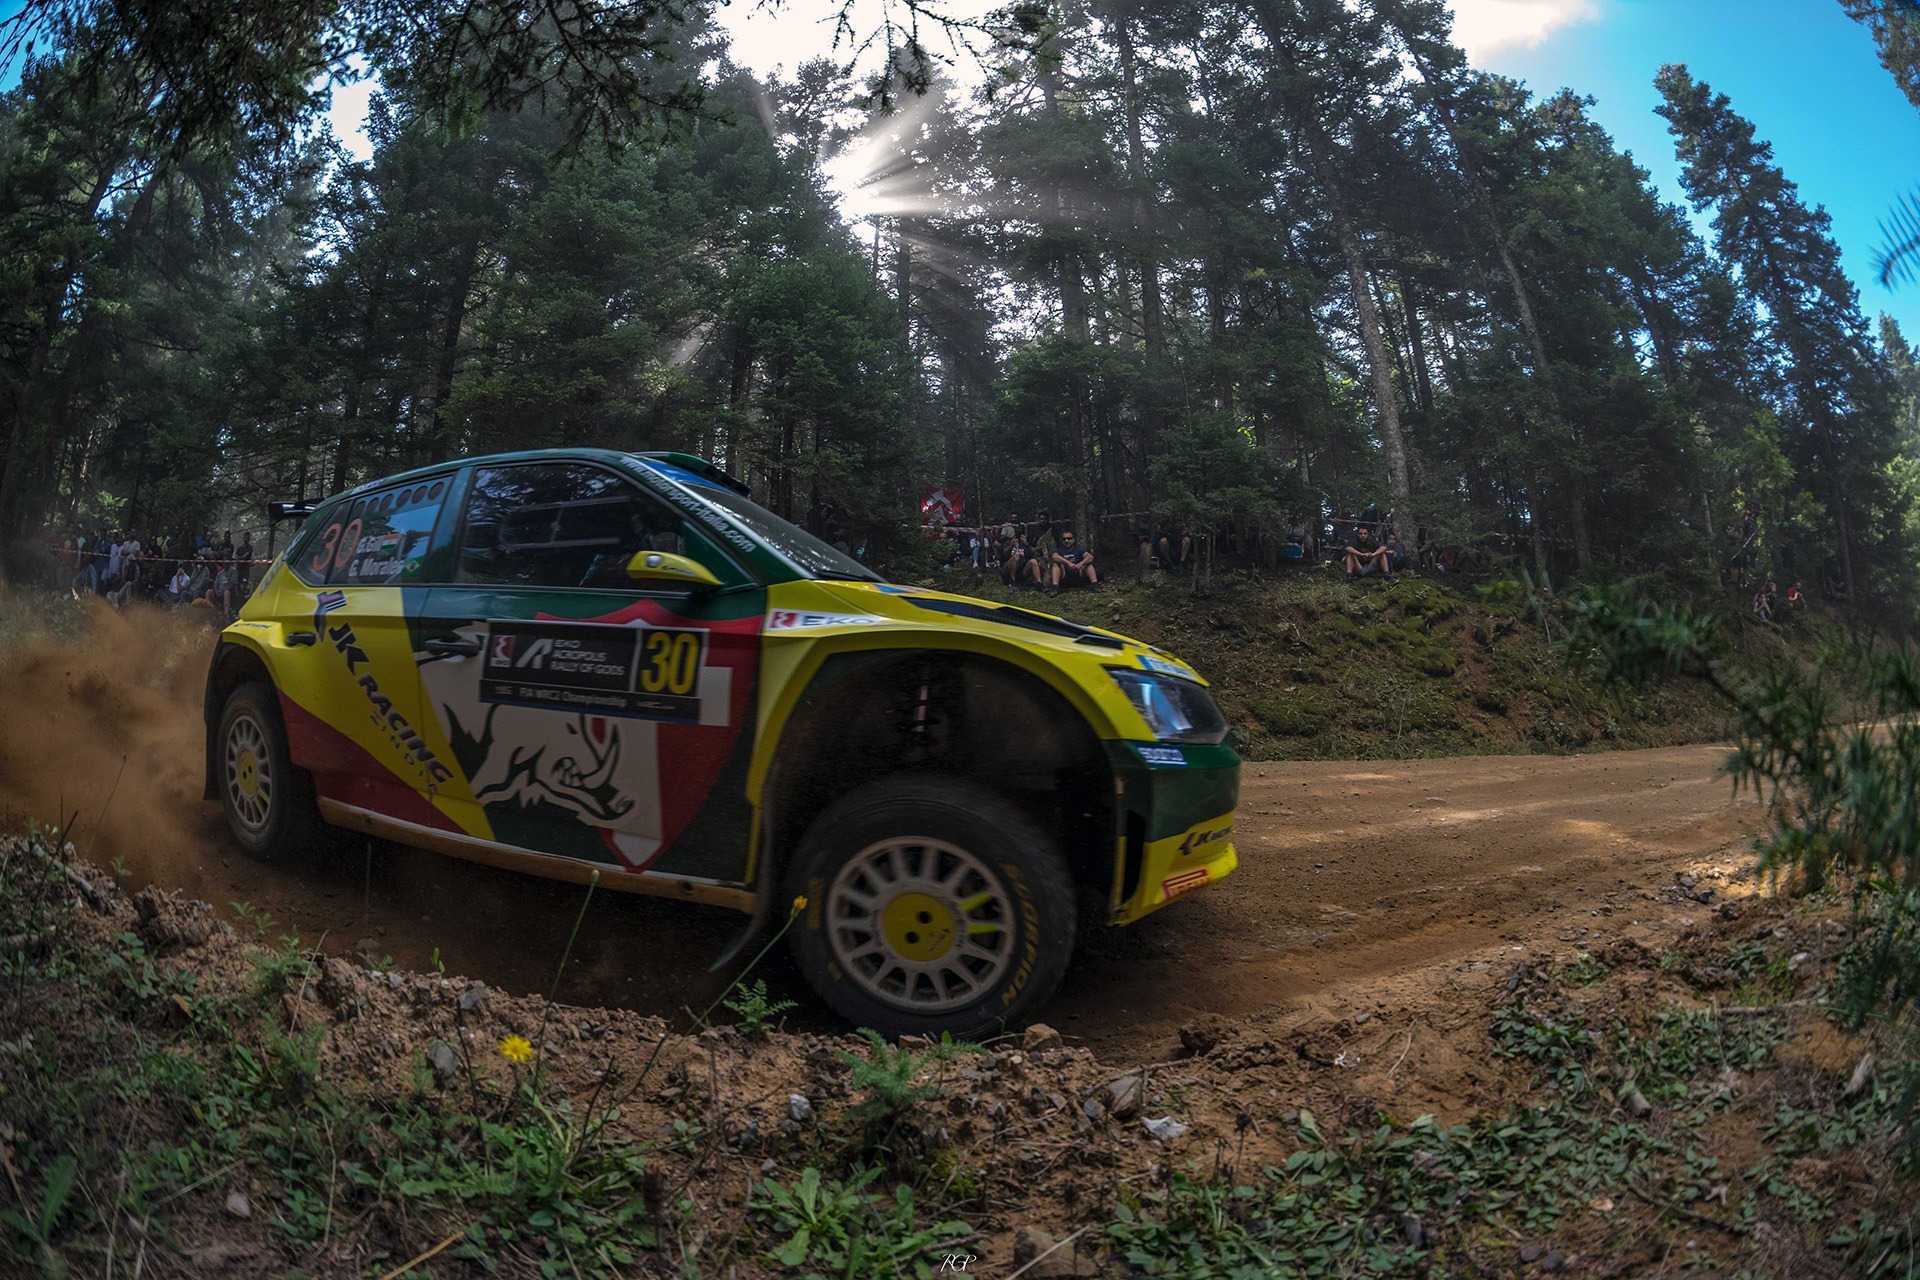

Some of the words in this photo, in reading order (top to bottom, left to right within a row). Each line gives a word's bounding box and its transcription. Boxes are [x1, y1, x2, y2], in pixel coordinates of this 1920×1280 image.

[619, 456, 757, 553] www.motorsport-italia.com
[313, 518, 363, 571] 30
[802, 614, 875, 627] EKO
[551, 649, 608, 662] ACROPOLIS
[580, 663, 595, 673] OF
[594, 664, 625, 676] GODS
[641, 631, 699, 695] 30
[328, 622, 370, 676] JK
[356, 672, 454, 784] RACING
[561, 691, 628, 709] Championship
